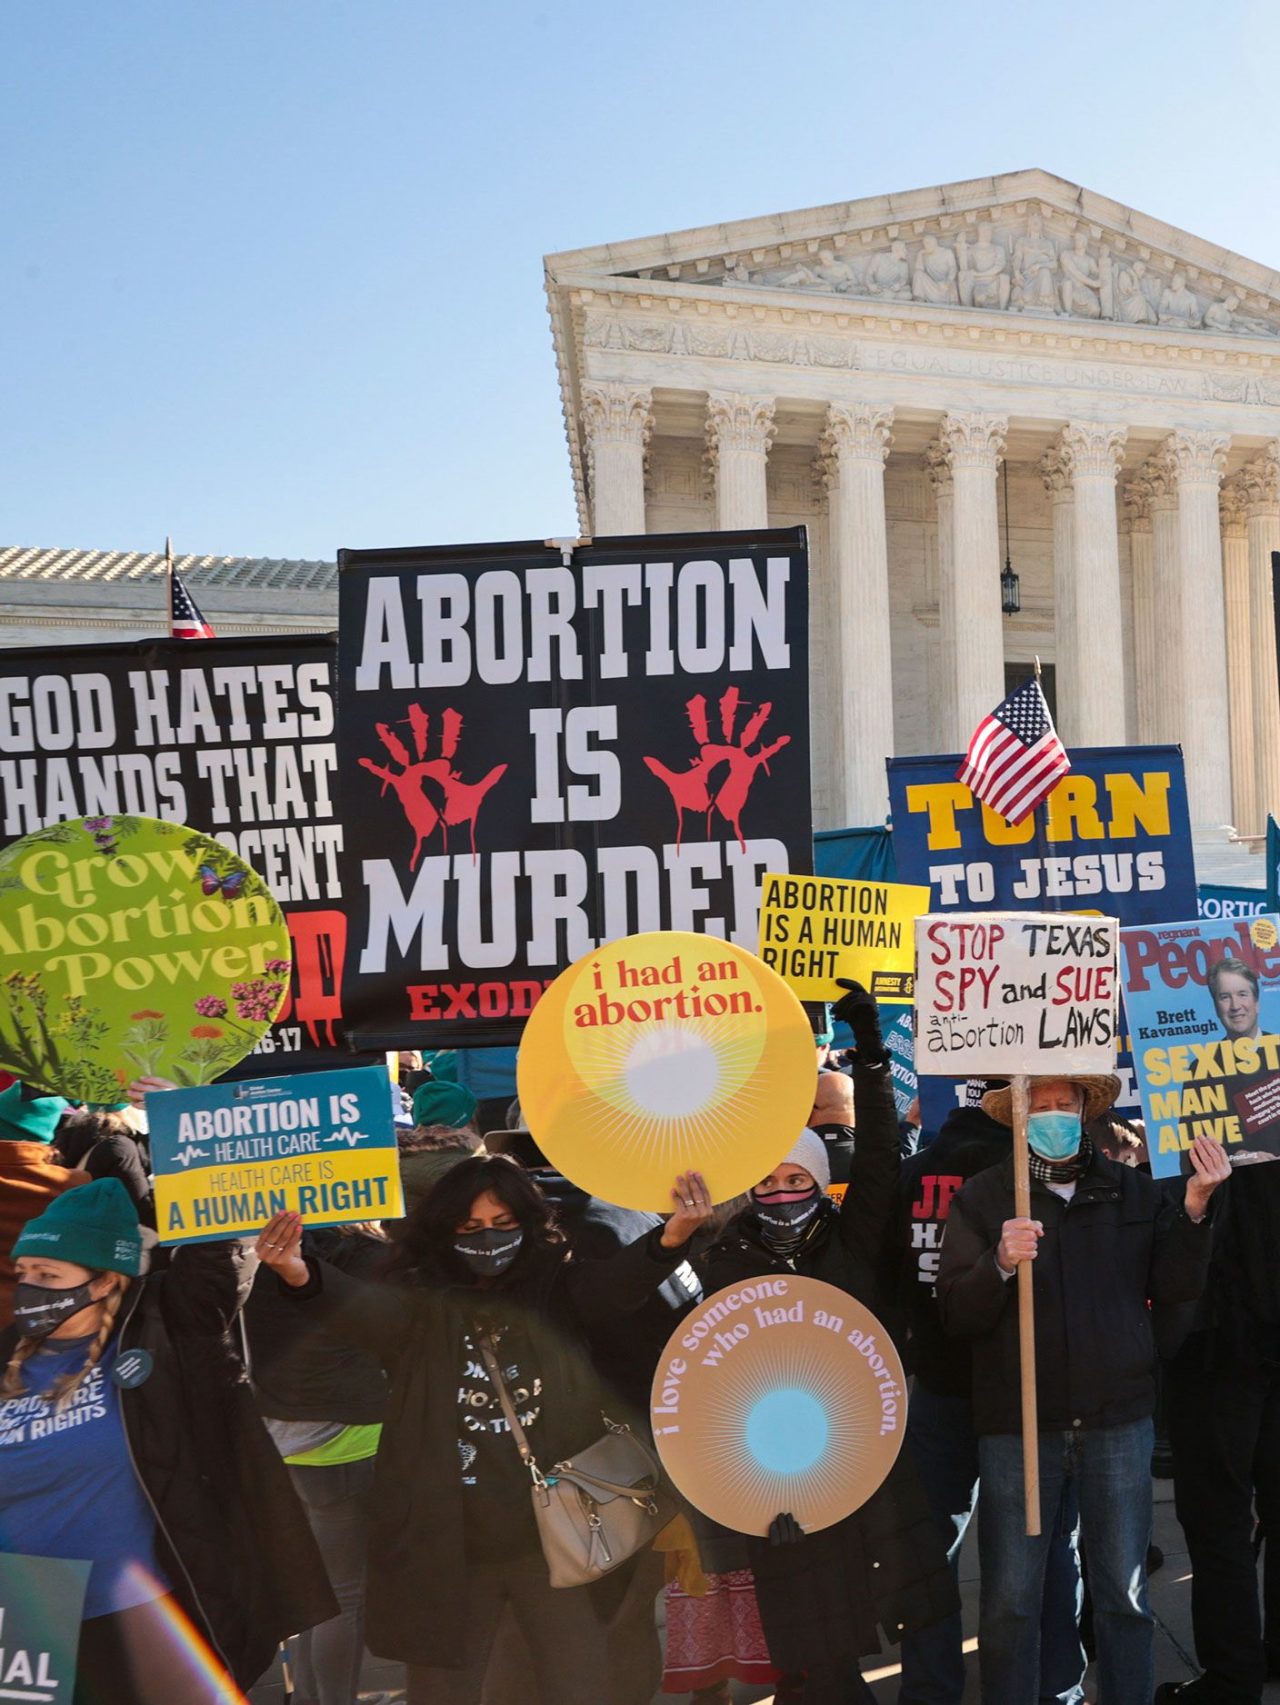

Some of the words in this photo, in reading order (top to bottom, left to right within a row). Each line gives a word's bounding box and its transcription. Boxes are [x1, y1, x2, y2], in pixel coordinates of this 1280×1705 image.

[876, 350, 957, 373] EQUAL
[964, 358, 1052, 383] JUSTICE
[1064, 367, 1137, 389] UNDER
[1146, 374, 1186, 392] LAW
[355, 556, 791, 691] ABORTION
[0, 672, 116, 753] GOD
[129, 662, 334, 747] HATES
[529, 705, 621, 823] IS
[0, 751, 188, 837] HANDS
[196, 743, 338, 824] THAT
[19, 847, 206, 909] Grow
[766, 880, 888, 916] ABORTION
[929, 861, 996, 905] TO
[1013, 851, 1166, 900] JESUS
[765, 914, 789, 943] IS
[798, 916, 813, 944] A
[823, 917, 902, 949] HUMAN
[927, 921, 1005, 966] STOP
[1021, 924, 1111, 958] TEXAS
[45, 938, 279, 998] Power
[592, 961, 603, 991] i
[617, 955, 683, 988] had
[697, 959, 740, 983] an
[763, 947, 840, 979] RIGHT
[406, 980, 560, 1022] EXOD
[573, 985, 763, 1028] abortion.
[933, 964, 1000, 1012] SPY
[1002, 973, 1047, 1004] and
[1052, 965, 1113, 1006] SUE
[927, 1017, 1025, 1053] abortion
[929, 1013, 968, 1027] anti-
[1138, 1020, 1219, 1040] Kavanaugh
[1156, 1008, 1197, 1025] Brett
[177, 1097, 319, 1144] ABORTION
[330, 1093, 360, 1125] IS
[1149, 1083, 1228, 1122] MAN
[214, 1134, 273, 1163] HEALTH
[277, 1130, 322, 1156] CARE
[1158, 1115, 1243, 1154] ALIVE
[210, 1167, 266, 1193] HEALTH
[270, 1163, 312, 1186] CARE
[319, 1160, 334, 1180] IS
[168, 1201, 185, 1231] A
[193, 1188, 287, 1228] HUMAN
[297, 1176, 389, 1215] RIGHT
[682, 1278, 788, 1351] someone
[652, 1357, 688, 1414] love
[701, 1322, 750, 1368] who
[753, 1301, 804, 1329] had
[813, 1310, 844, 1334] an
[847, 1328, 902, 1436] abortion.
[31, 1400, 107, 1440] RIGHTS
